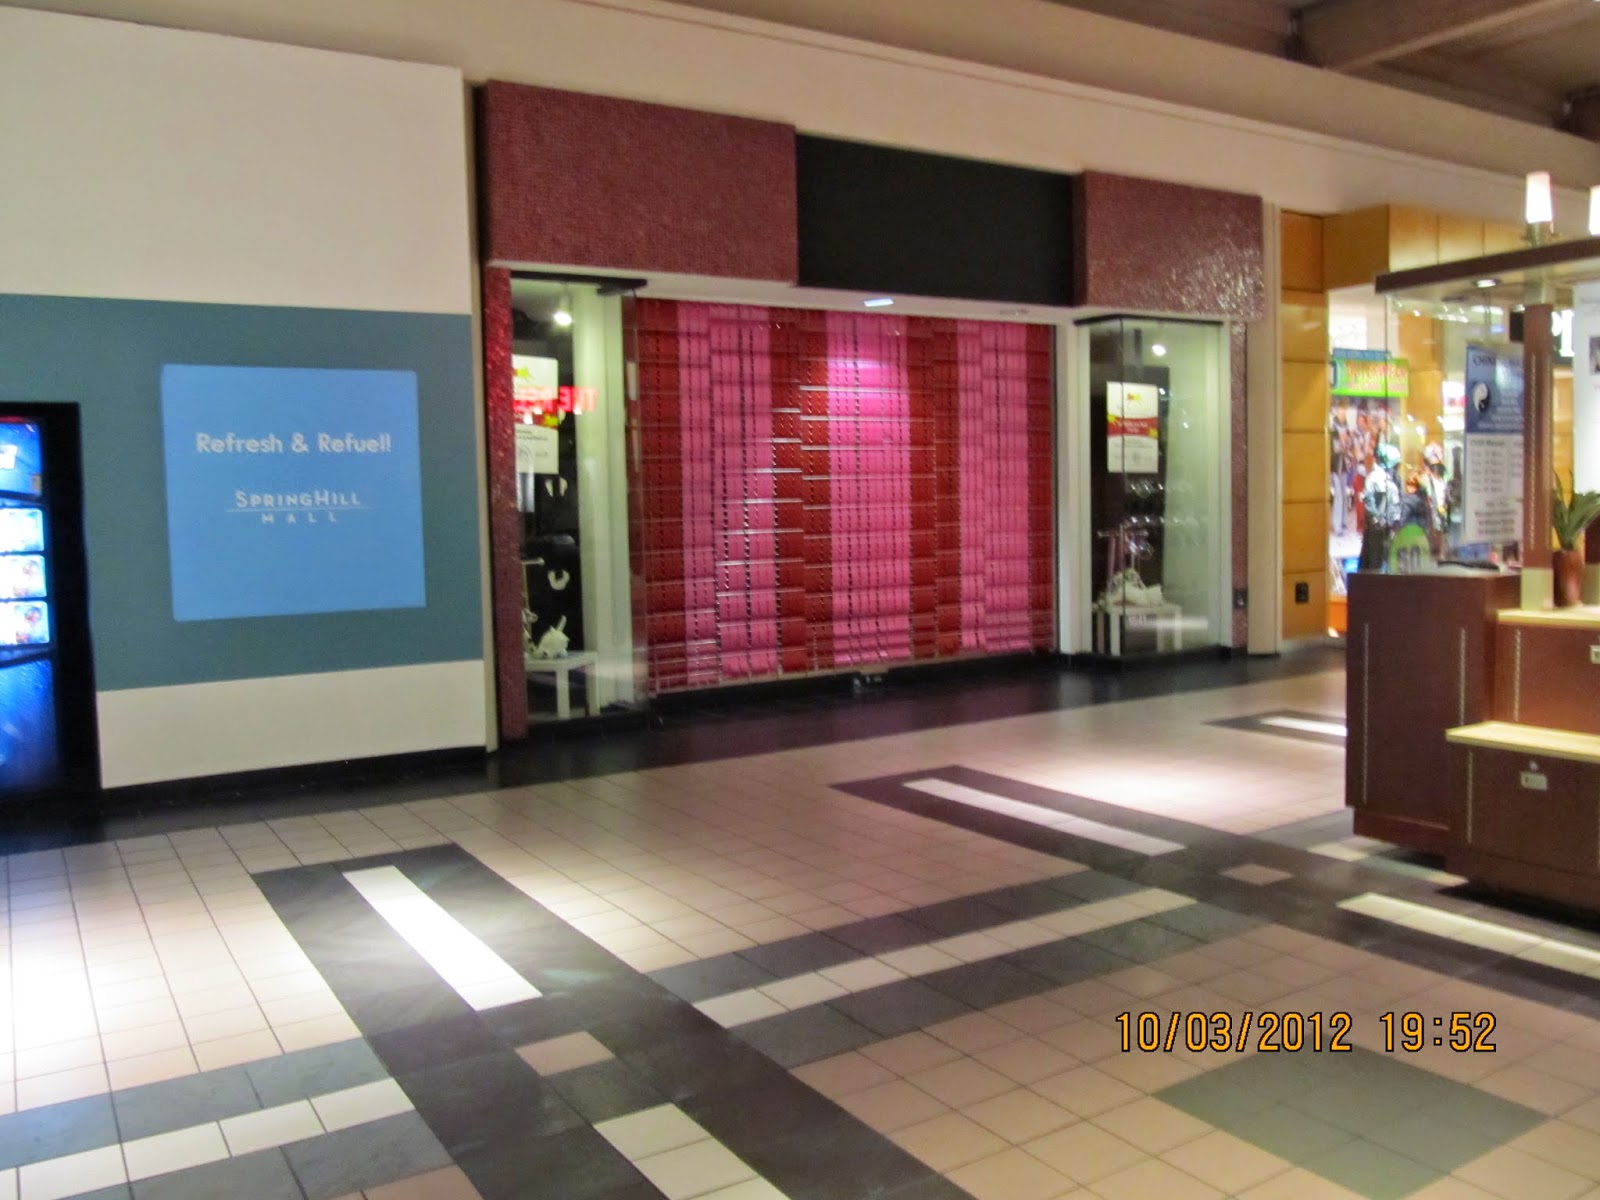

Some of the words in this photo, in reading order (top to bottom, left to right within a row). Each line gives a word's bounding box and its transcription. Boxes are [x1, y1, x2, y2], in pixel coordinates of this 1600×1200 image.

[196, 432, 283, 453] Refresh
[292, 432, 310, 453] &
[317, 432, 391, 453] Refuel!
[261, 512, 338, 524] MALL
